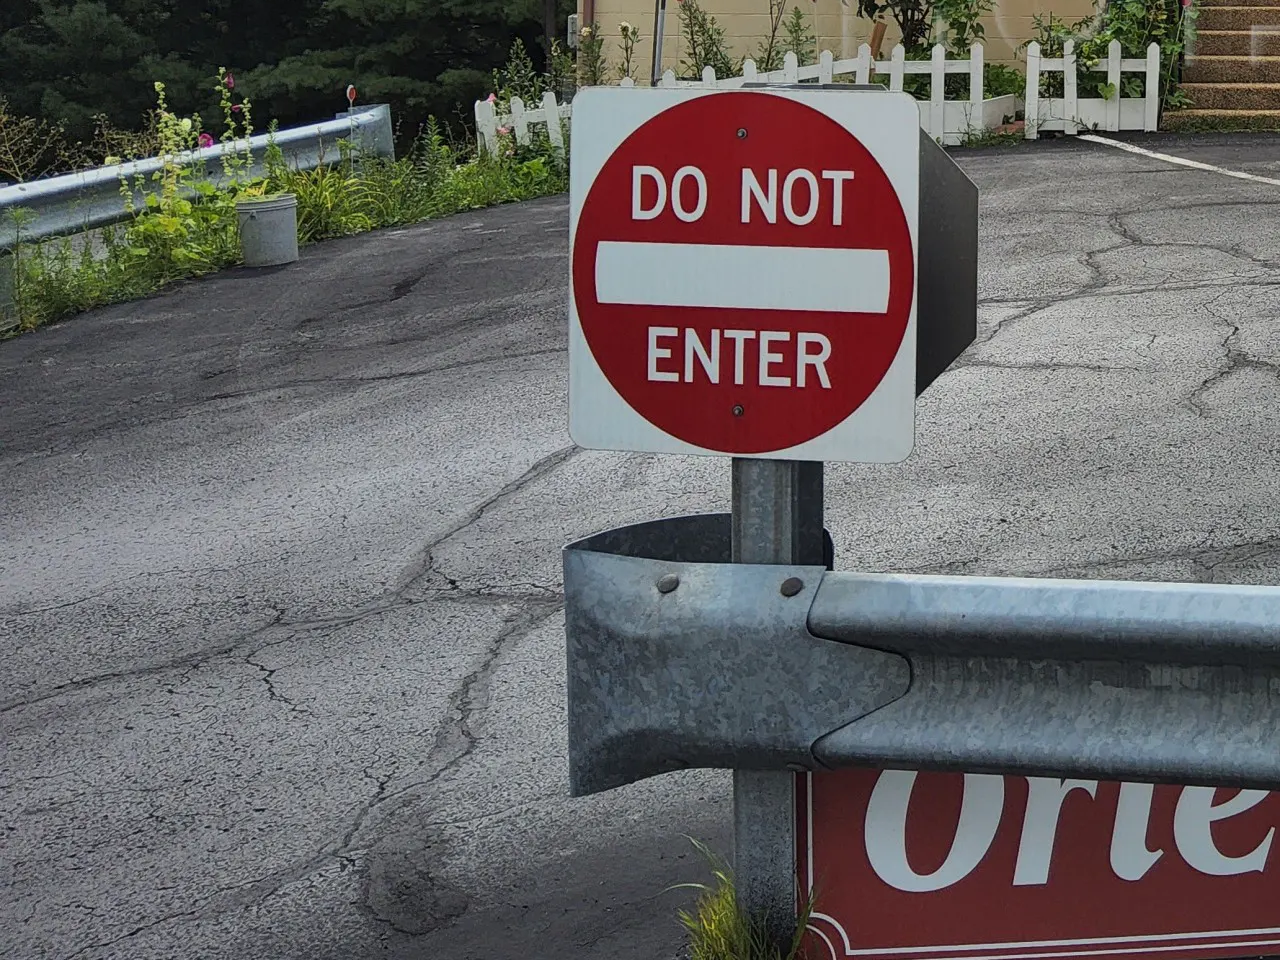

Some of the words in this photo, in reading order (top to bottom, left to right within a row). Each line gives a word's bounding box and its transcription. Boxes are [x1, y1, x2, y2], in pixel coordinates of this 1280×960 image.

[631, 164, 709, 224] DO
[740, 167, 855, 227] NOT
[646, 325, 832, 390] ENTER
